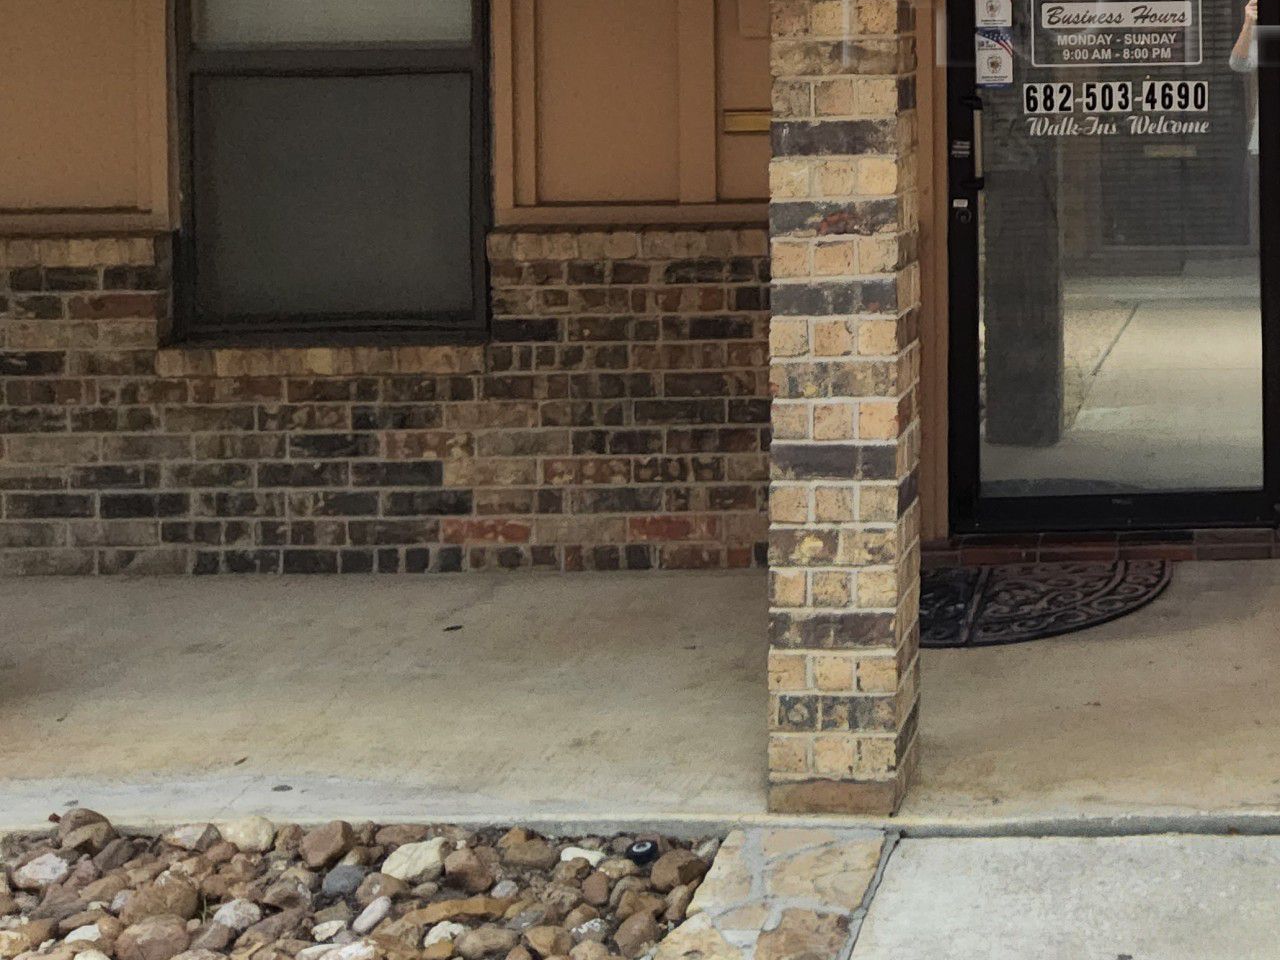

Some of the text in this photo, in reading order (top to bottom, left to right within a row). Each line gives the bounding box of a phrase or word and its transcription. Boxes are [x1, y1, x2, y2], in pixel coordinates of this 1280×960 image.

[1046, 4, 1187, 25] Business Hours
[1057, 33, 1113, 47] MONDAY
[1124, 33, 1177, 45] SUNDAY
[1062, 48, 1089, 60] 9:00
[1091, 48, 1112, 60] AM
[1122, 48, 1149, 59] 8:00
[1152, 47, 1172, 59] PM
[1024, 81, 1207, 114] 682-503-4690
[1026, 115, 1210, 136] Walk-Ins Welcome
